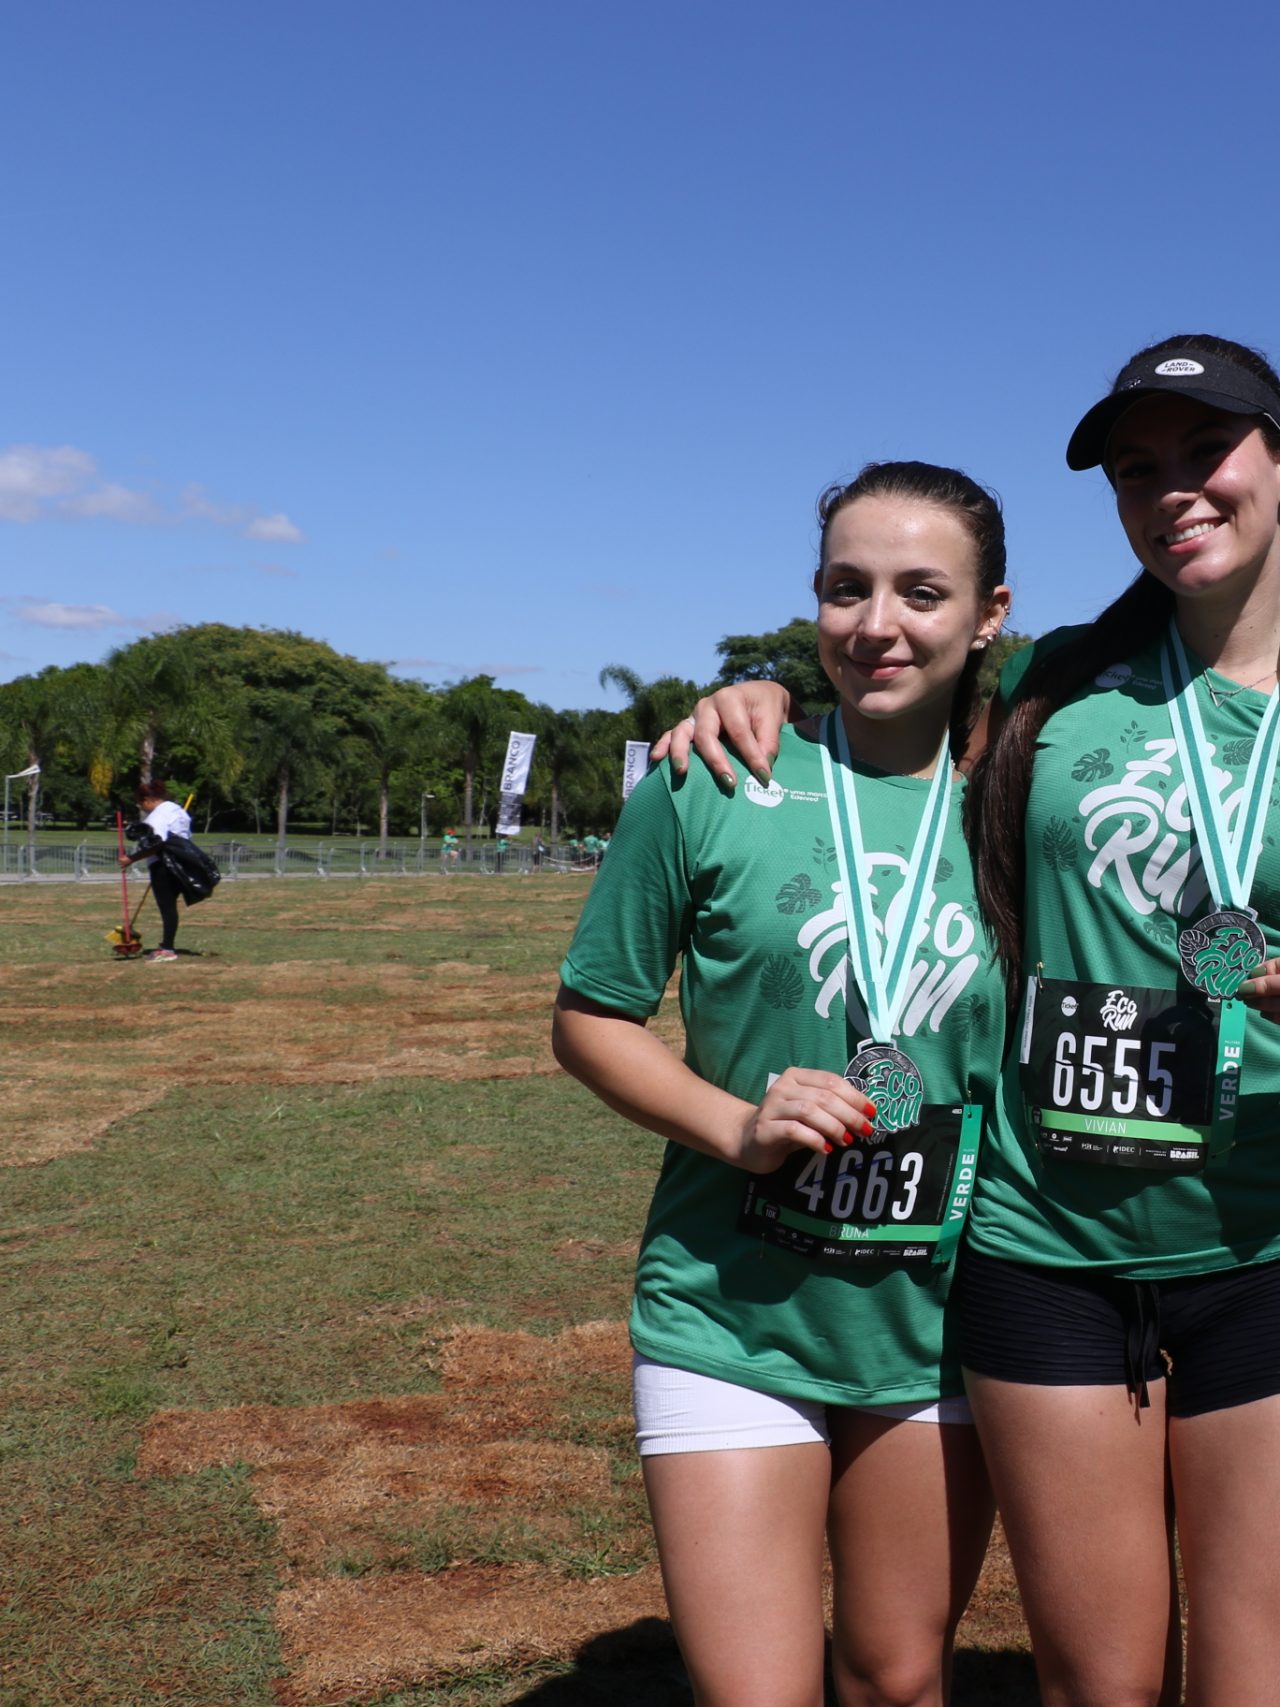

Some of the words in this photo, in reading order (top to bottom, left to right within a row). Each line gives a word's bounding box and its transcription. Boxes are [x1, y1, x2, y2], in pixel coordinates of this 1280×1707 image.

[503, 740, 521, 790] BRANCO
[625, 748, 636, 797] BRANCO
[744, 782, 785, 798] Ticket
[1053, 1032, 1176, 1117] 6555
[1218, 1046, 1241, 1120] VERDE
[1084, 1119, 1127, 1134] VIVIAN
[1169, 1150, 1200, 1159] BRASIL
[794, 1151, 924, 1220] 4663
[949, 1154, 975, 1221] VERDE
[829, 1224, 870, 1239] BRUNA
[903, 1248, 928, 1257] BRASIL
